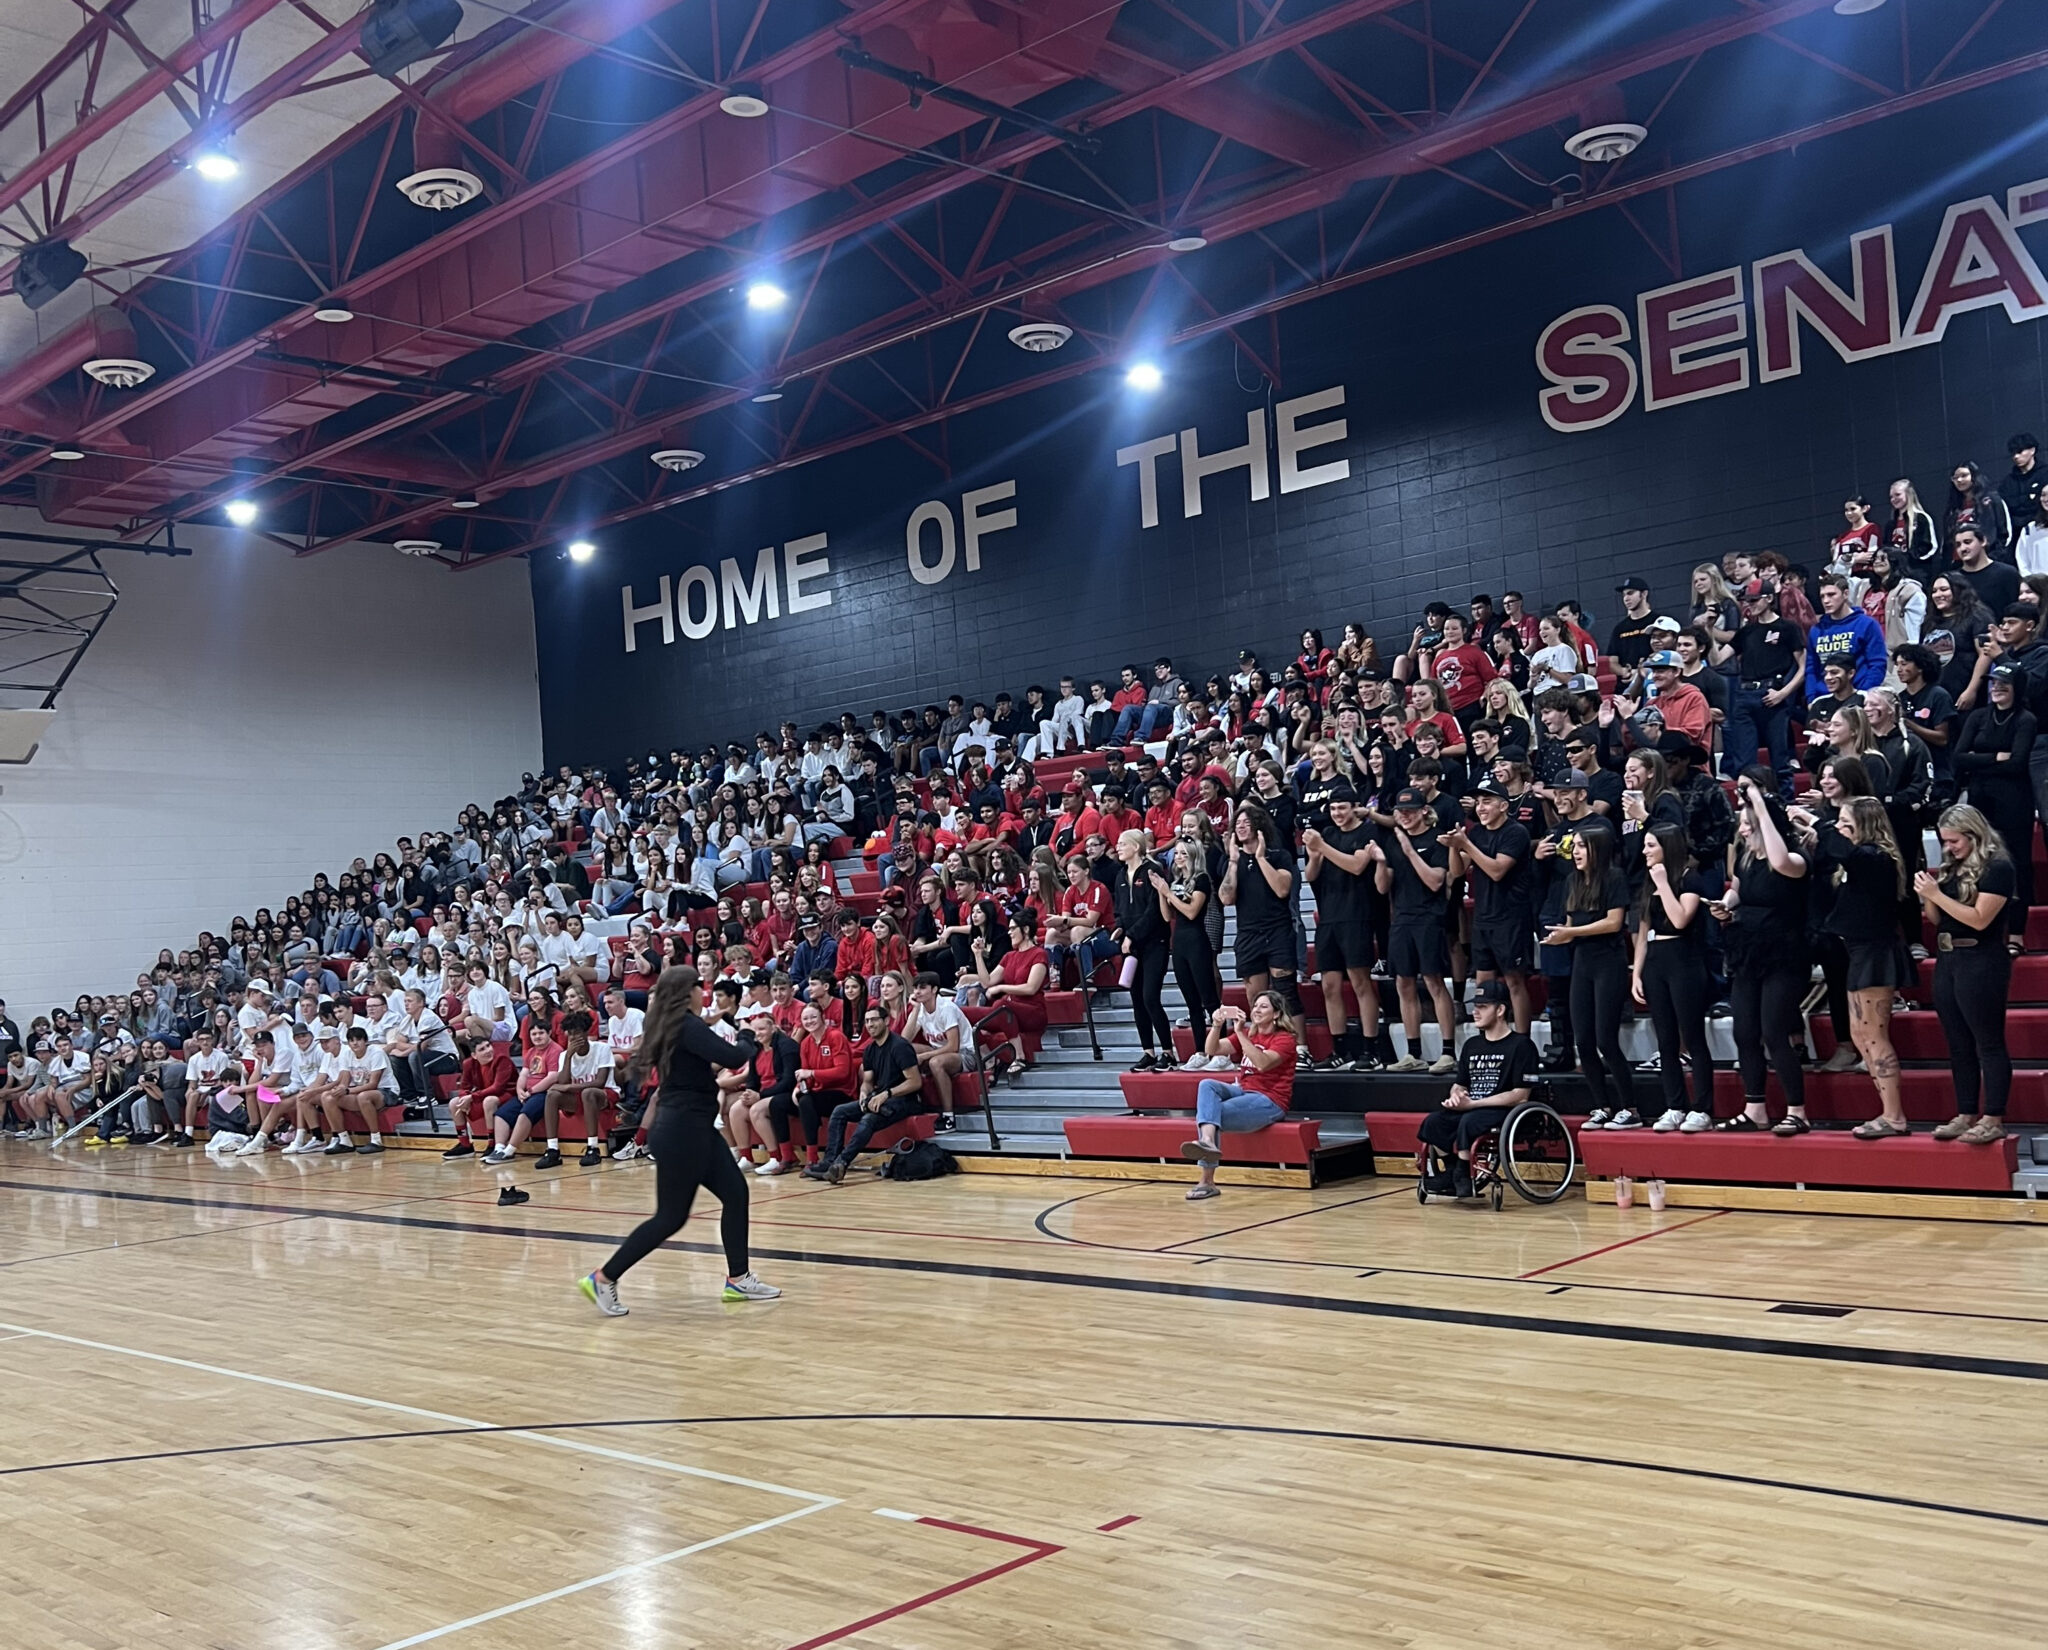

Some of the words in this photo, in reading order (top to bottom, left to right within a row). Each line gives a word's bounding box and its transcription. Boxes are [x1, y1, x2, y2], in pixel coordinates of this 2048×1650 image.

[621, 532, 832, 653] HOME
[905, 479, 1017, 585] OF
[1116, 385, 1350, 529] THE
[1832, 631, 1855, 641] NOT
